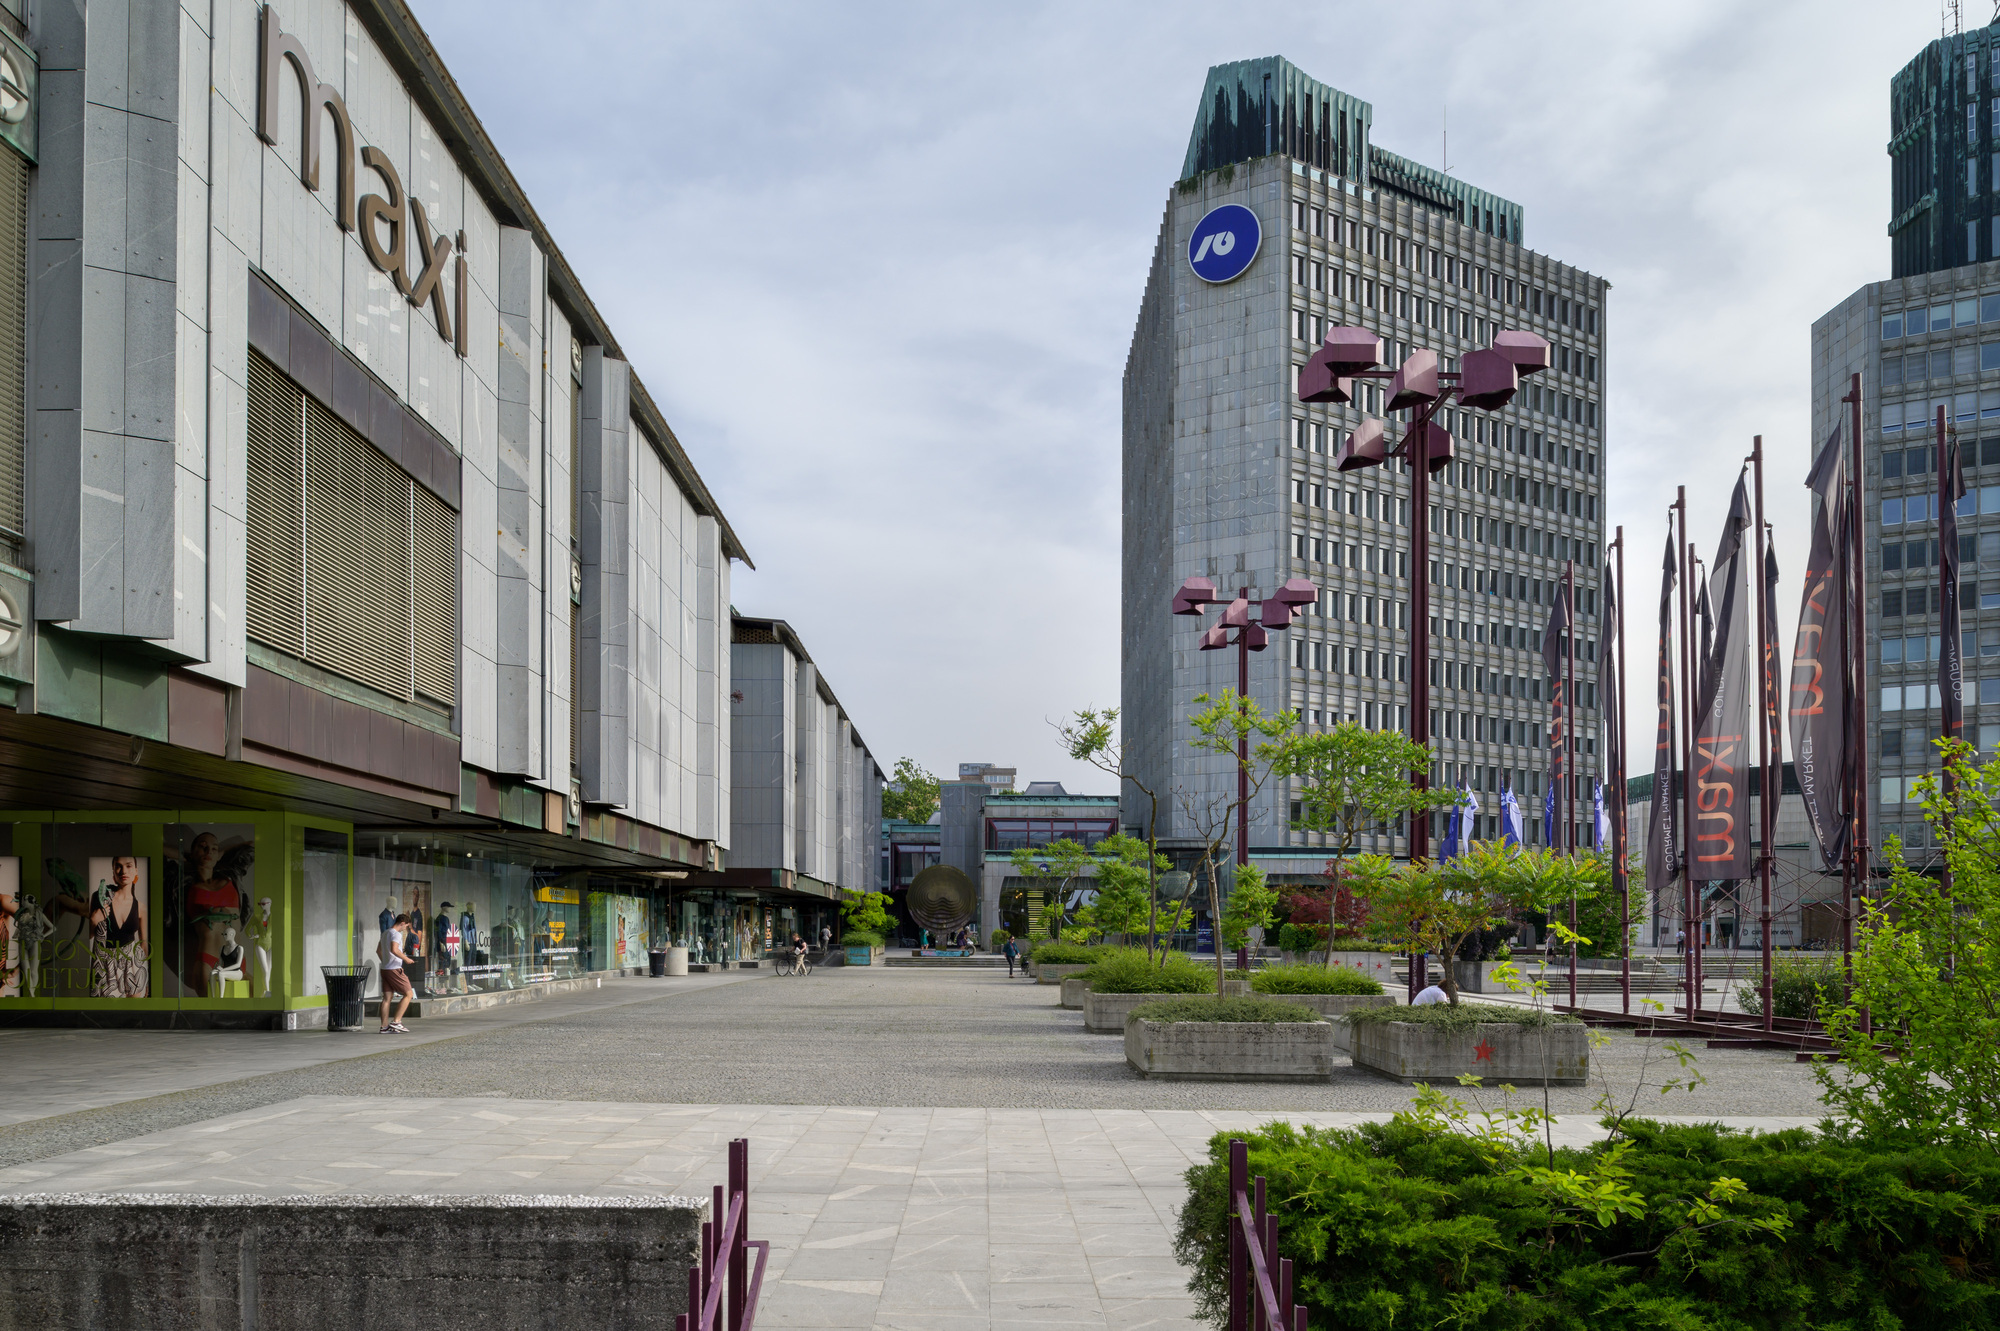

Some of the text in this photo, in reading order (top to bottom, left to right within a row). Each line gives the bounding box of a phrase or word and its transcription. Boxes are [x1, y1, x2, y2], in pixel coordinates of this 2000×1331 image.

[257, 3, 469, 358] maxi
[0, 938, 154, 961] ELEONSKO
[0, 967, 107, 990] OLETJE
